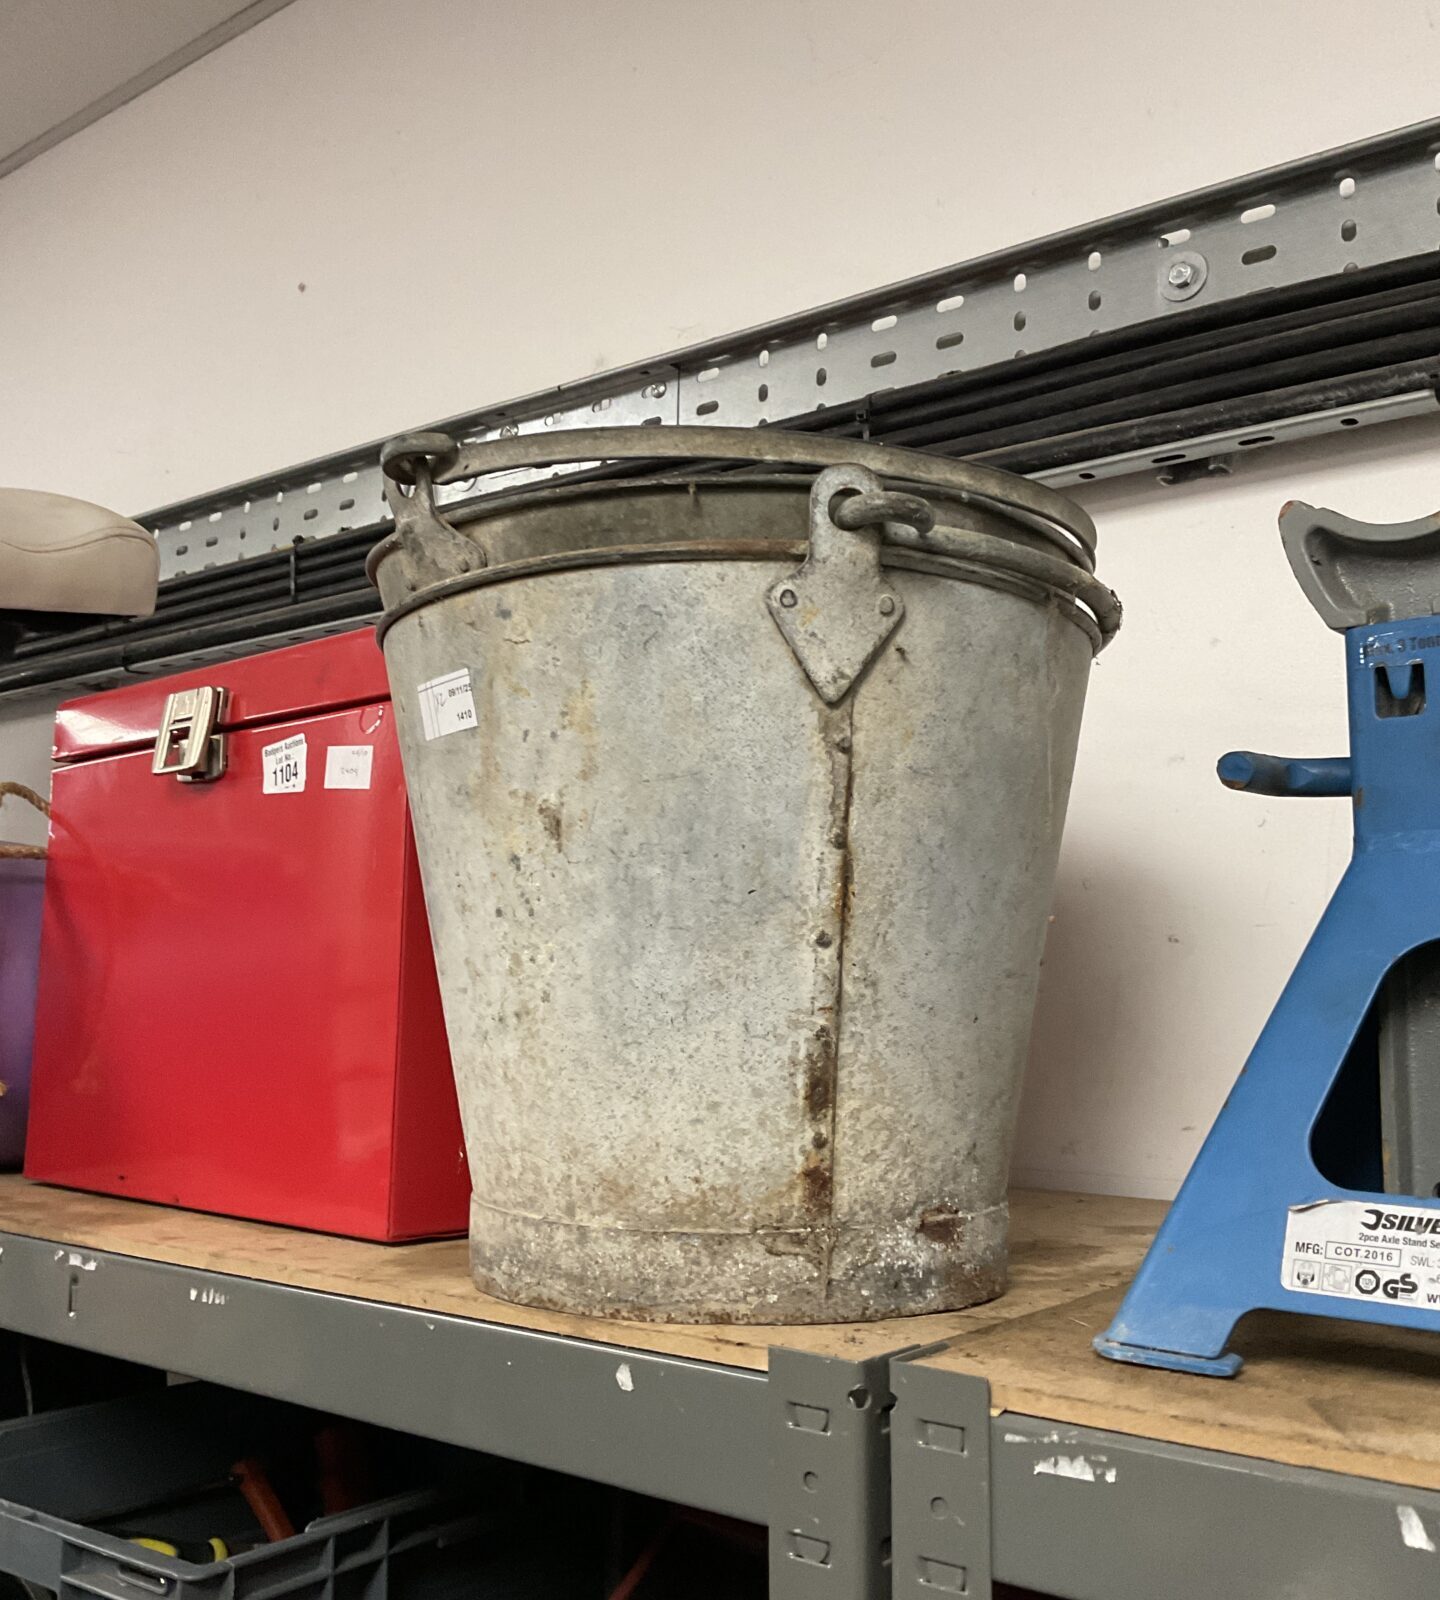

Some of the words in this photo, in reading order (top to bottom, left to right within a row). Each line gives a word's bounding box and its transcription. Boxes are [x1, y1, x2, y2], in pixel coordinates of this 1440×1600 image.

[457, 709, 472, 720] 1410
[272, 761, 299, 787] 1104
[1295, 1241, 1324, 1256] MFG:
[1358, 1232, 1379, 1244] 2pce
[1381, 1235, 1400, 1245] Axle
[1402, 1237, 1428, 1249] Stand
[1382, 1273, 1418, 1299] GS
